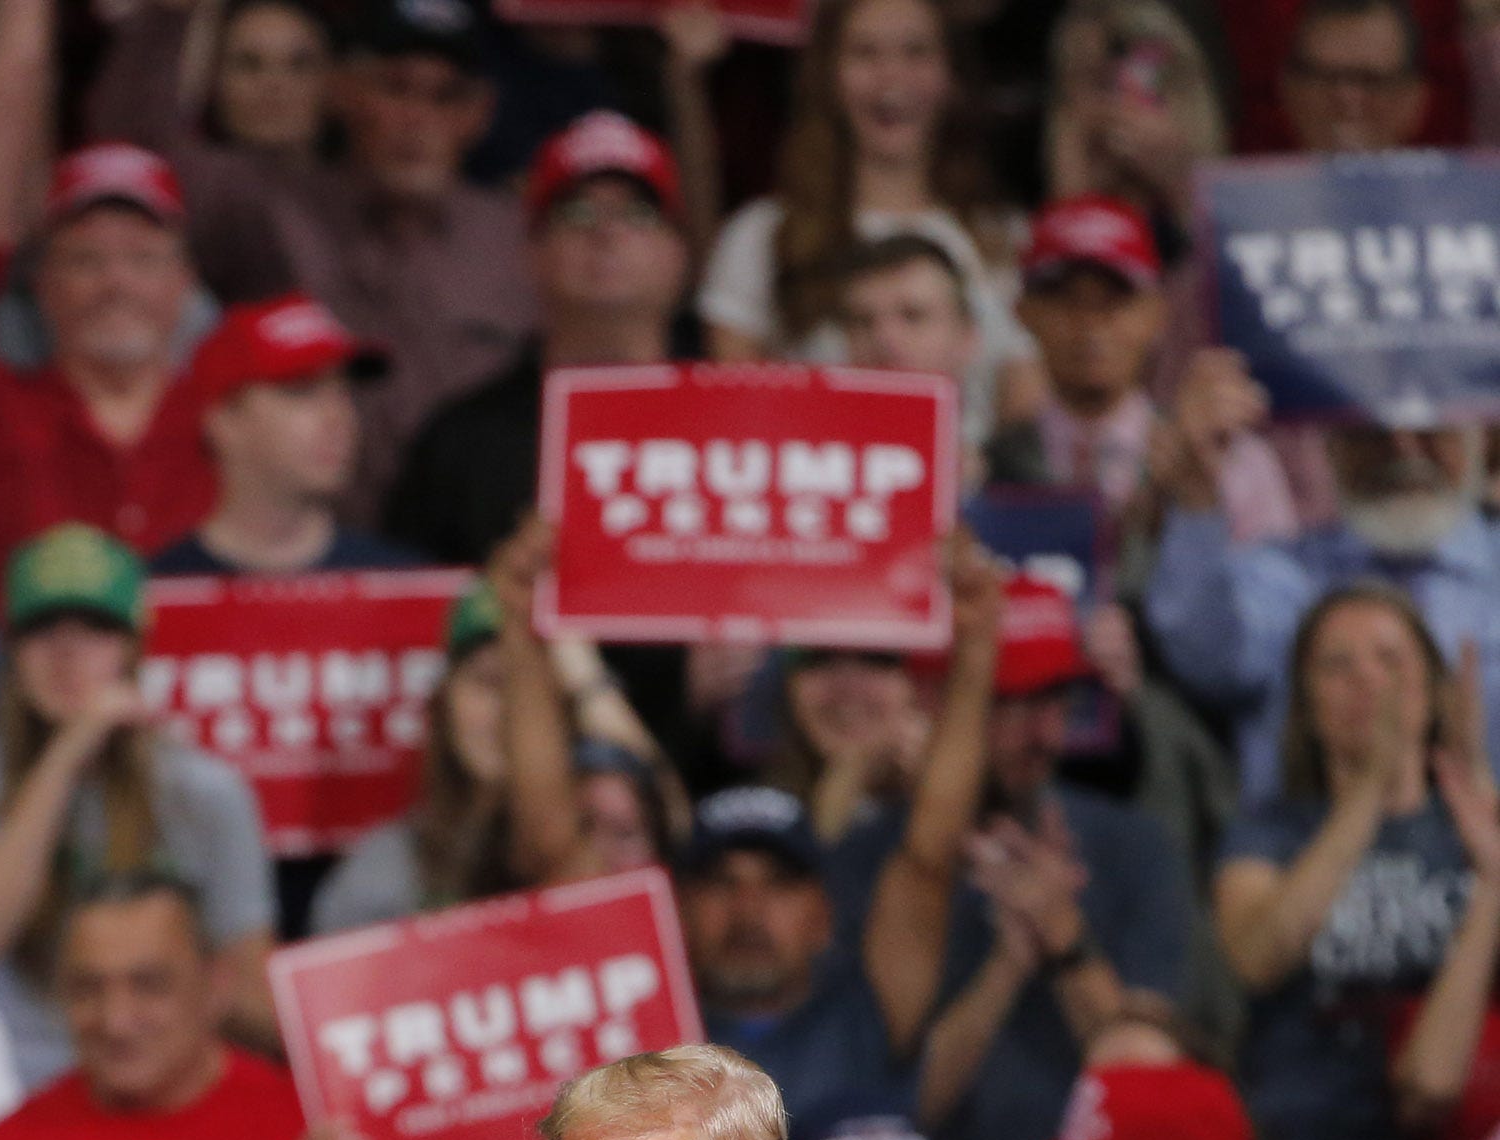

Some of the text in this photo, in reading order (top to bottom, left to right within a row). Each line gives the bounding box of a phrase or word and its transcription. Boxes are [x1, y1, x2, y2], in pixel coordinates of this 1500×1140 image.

[573, 438, 926, 499] TRUMP
[601, 496, 890, 544] PENCE
[318, 951, 662, 1077] TRUMP
